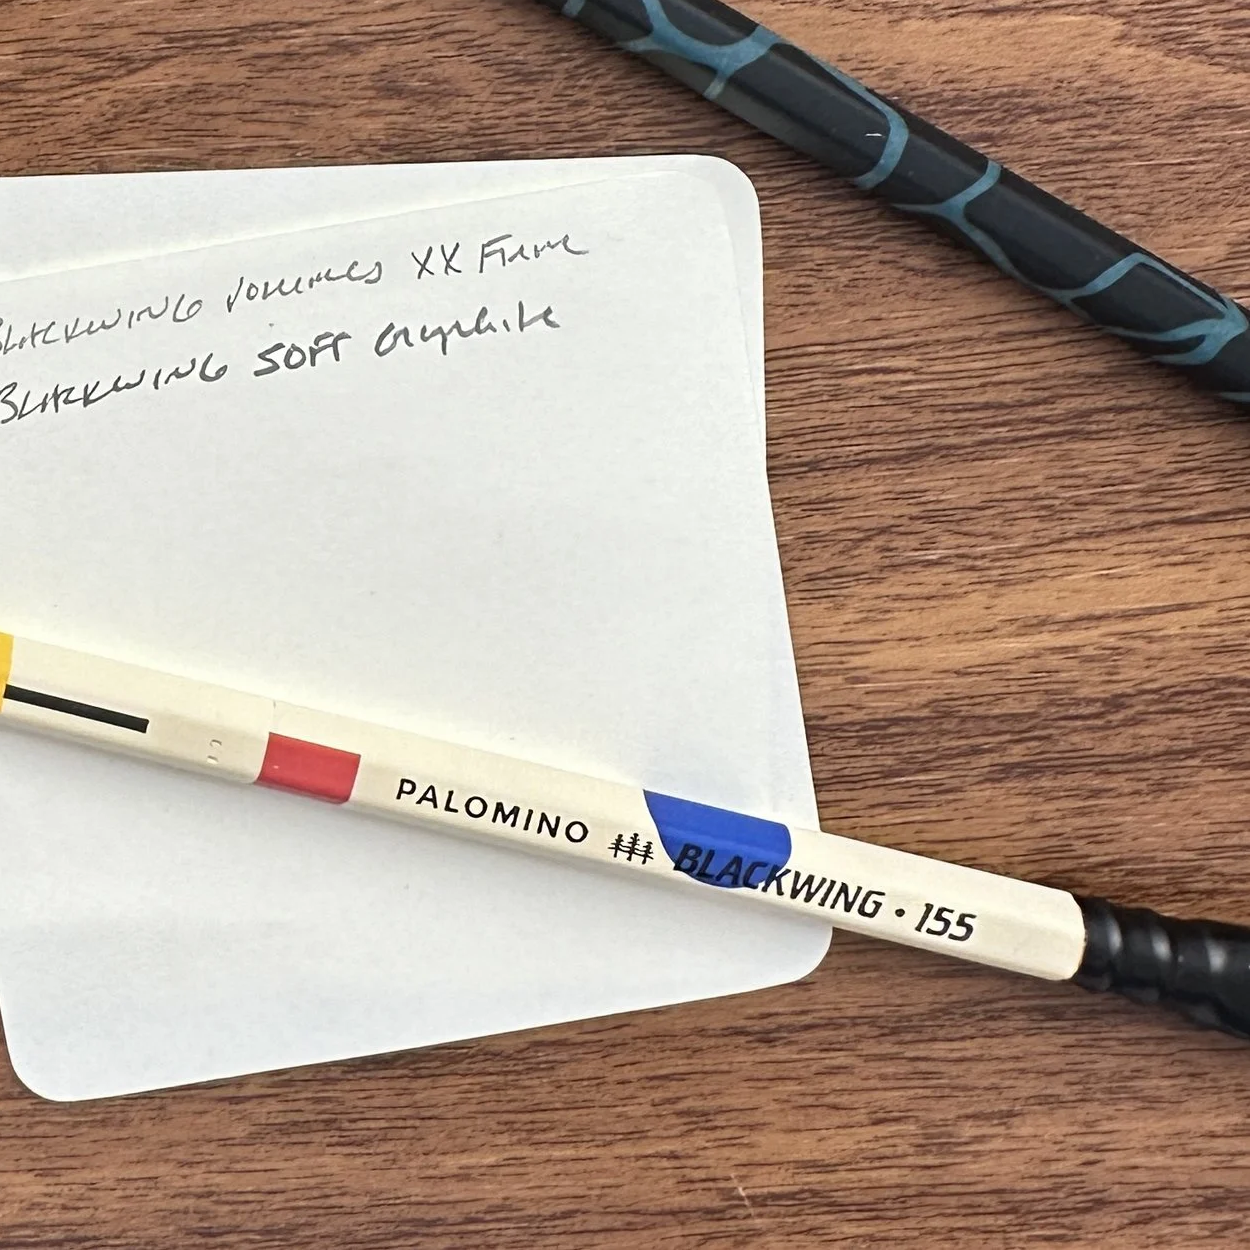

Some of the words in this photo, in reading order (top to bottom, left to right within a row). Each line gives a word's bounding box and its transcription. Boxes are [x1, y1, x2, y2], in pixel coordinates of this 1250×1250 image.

[396, 778, 589, 844] PALOMINO
[673, 841, 886, 919] BLACKWING
[915, 902, 977, 942] 155
